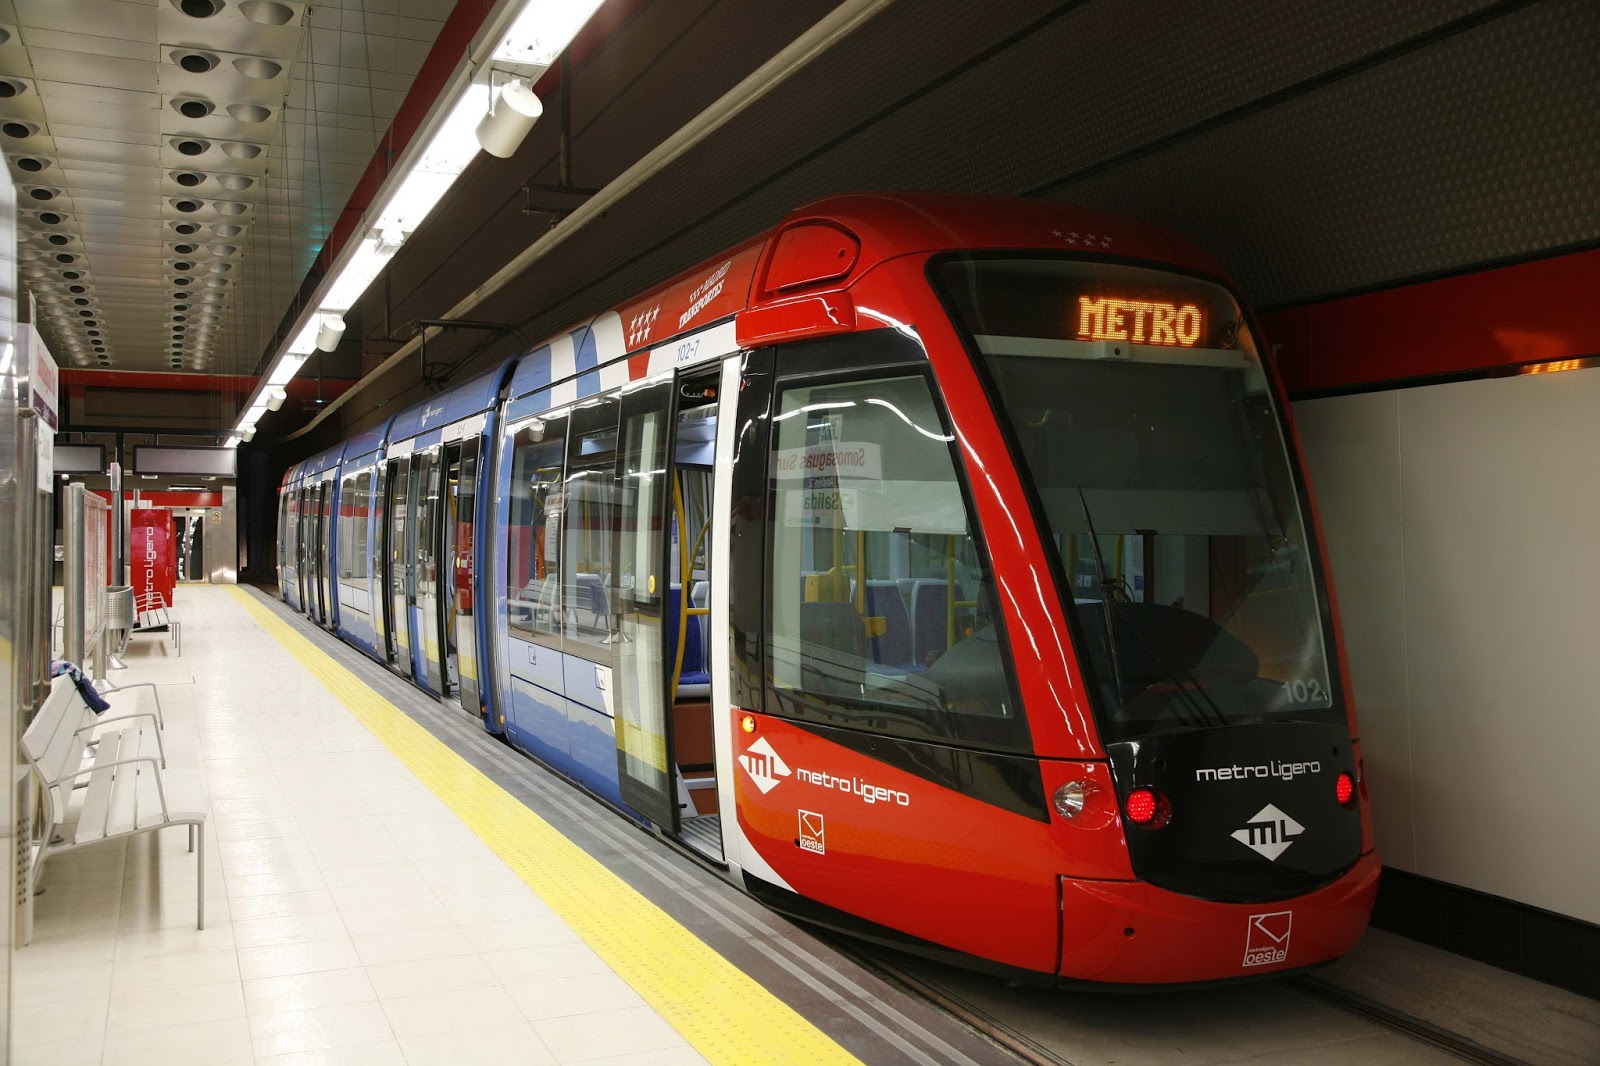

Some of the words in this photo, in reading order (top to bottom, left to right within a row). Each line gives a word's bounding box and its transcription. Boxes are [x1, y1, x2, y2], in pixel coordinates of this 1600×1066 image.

[1078, 297, 1202, 345] METRO
[677, 340, 700, 362] 102-7
[1281, 678, 1323, 703] 102
[801, 838, 823, 851] oeste
[1246, 949, 1285, 964] oeste
